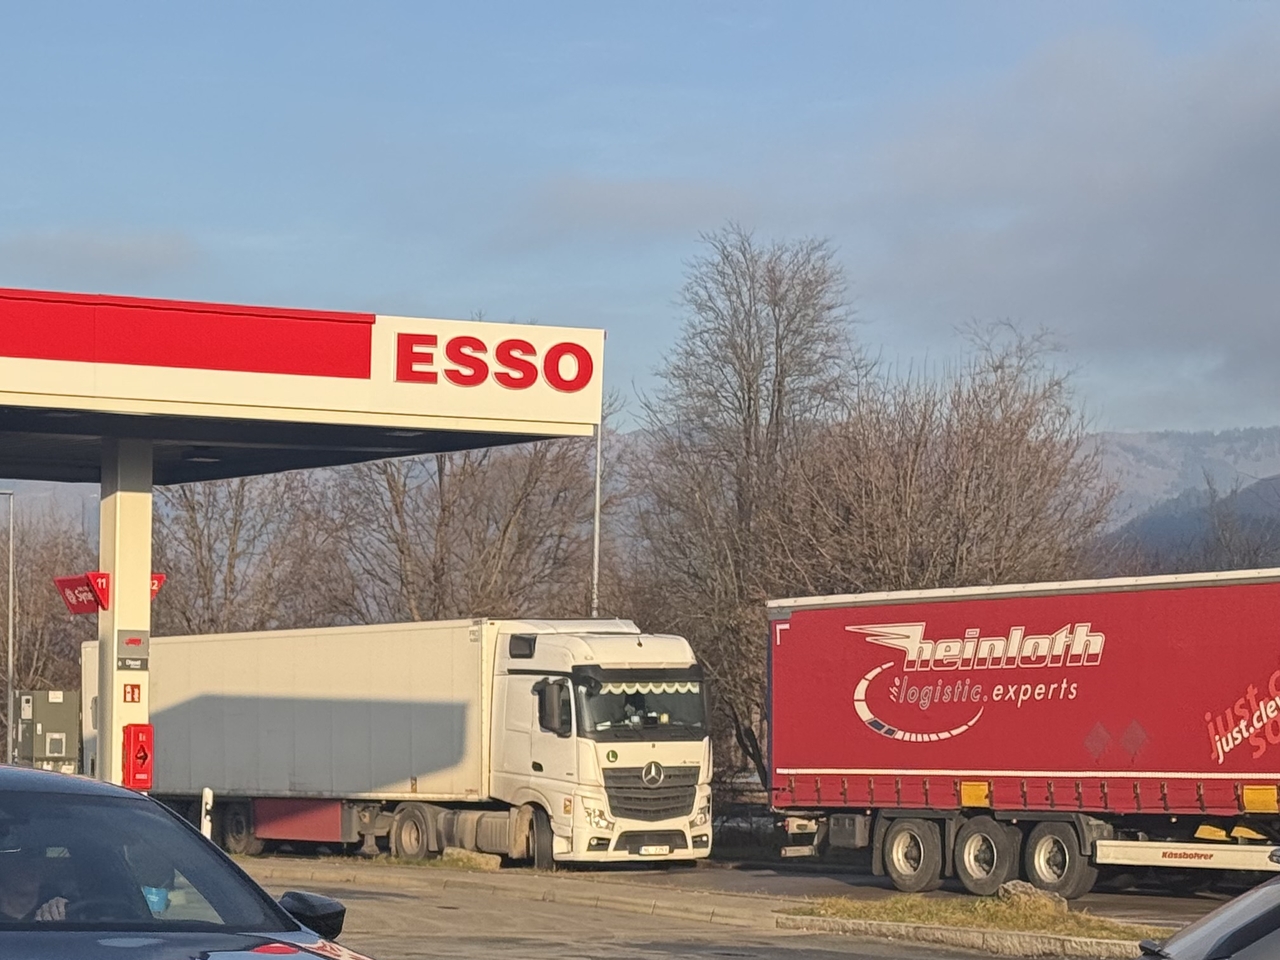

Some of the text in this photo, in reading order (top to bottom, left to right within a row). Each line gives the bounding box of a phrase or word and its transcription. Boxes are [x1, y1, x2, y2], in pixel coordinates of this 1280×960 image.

[395, 332, 594, 393] ESSO
[97, 578, 107, 589] 11
[845, 622, 1106, 671] heinloth
